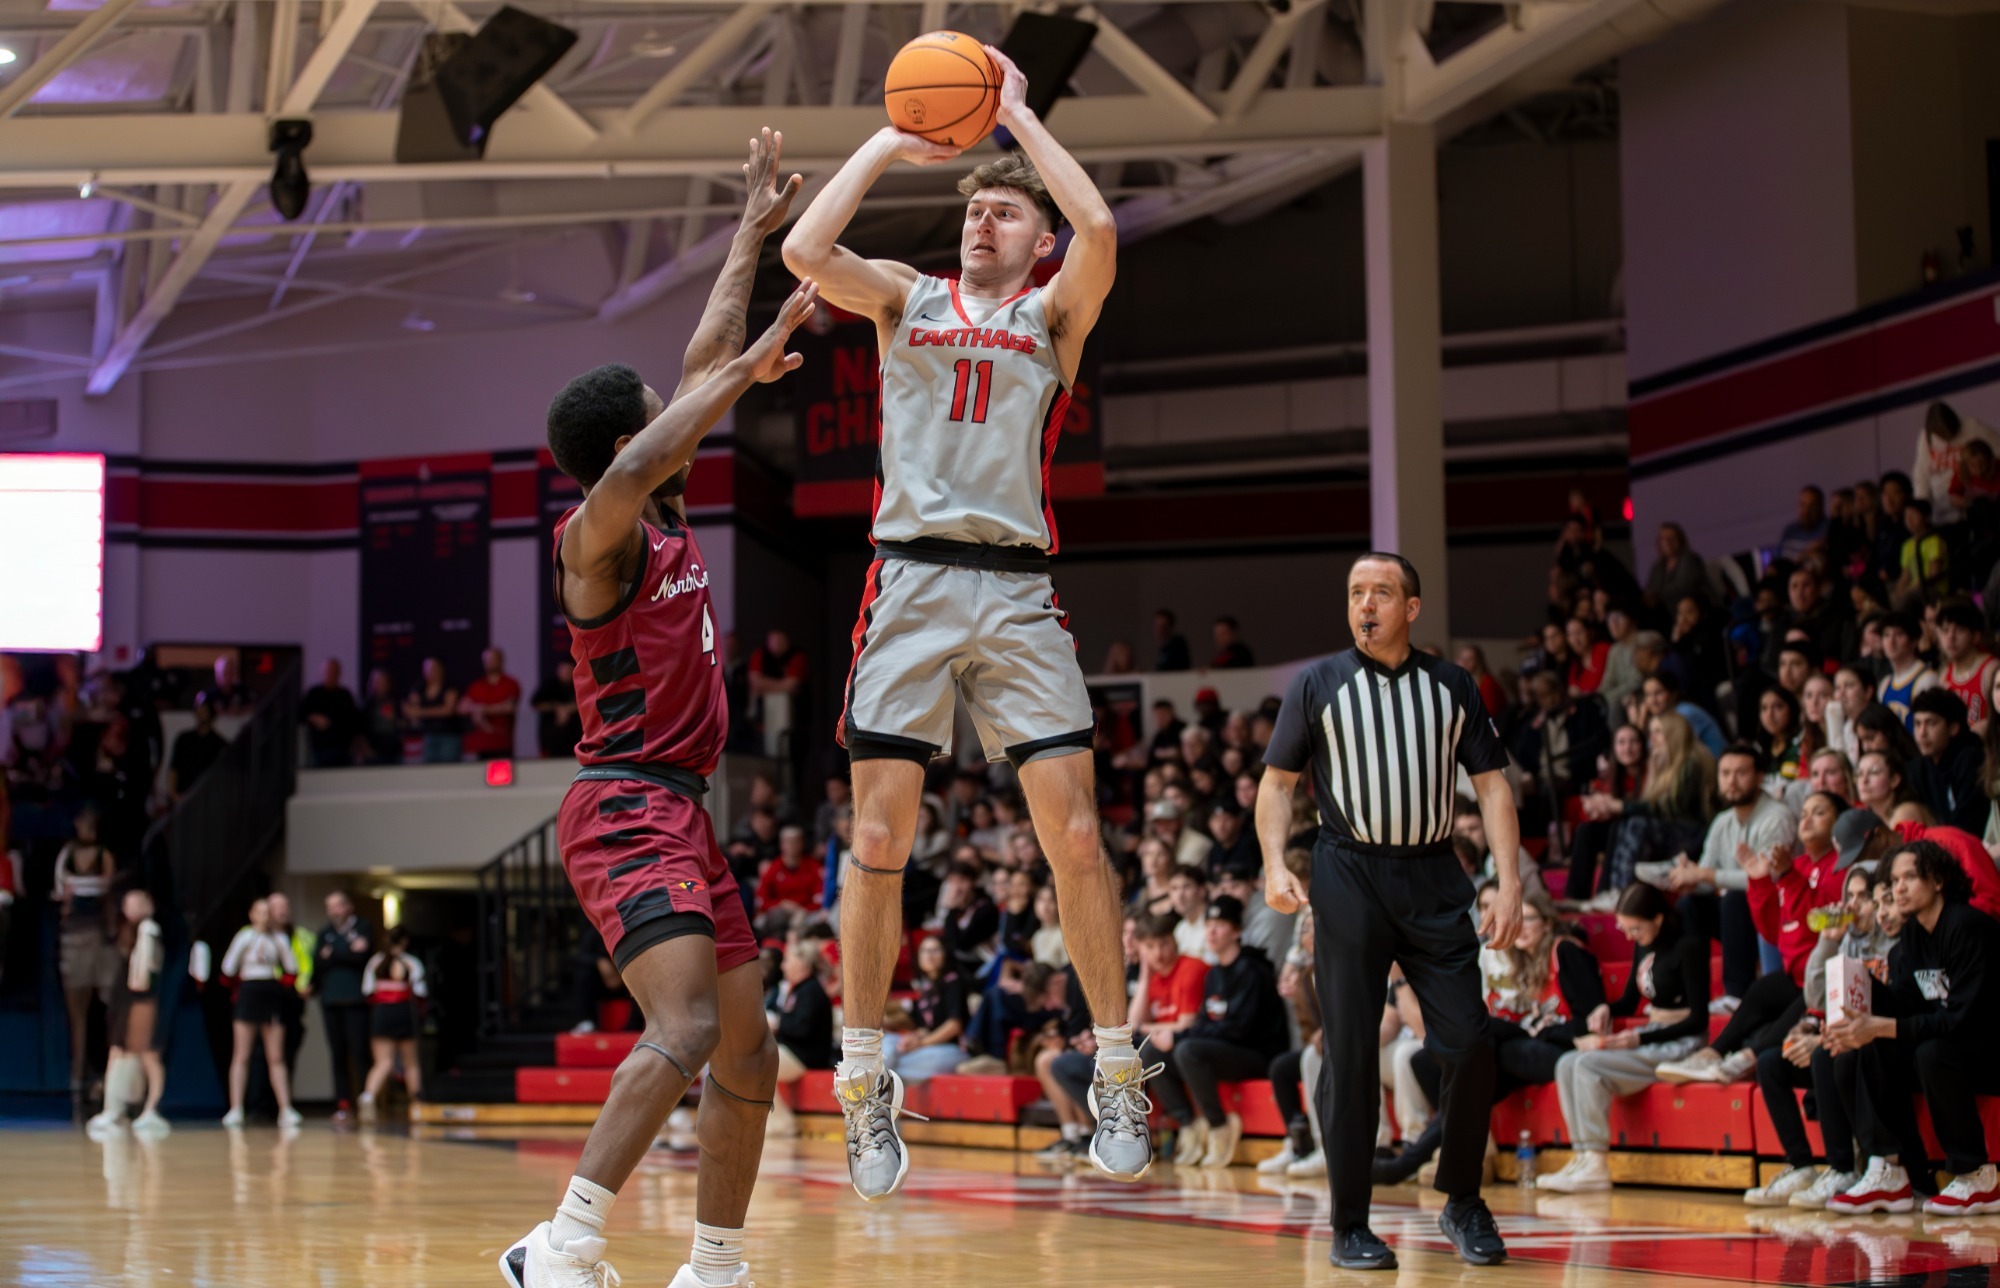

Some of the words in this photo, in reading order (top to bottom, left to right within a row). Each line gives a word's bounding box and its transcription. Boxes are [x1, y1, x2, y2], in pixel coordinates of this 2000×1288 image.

[909, 327, 1037, 355] CARTHAGE
[949, 358, 993, 424] 11
[702, 603, 717, 666] 4
